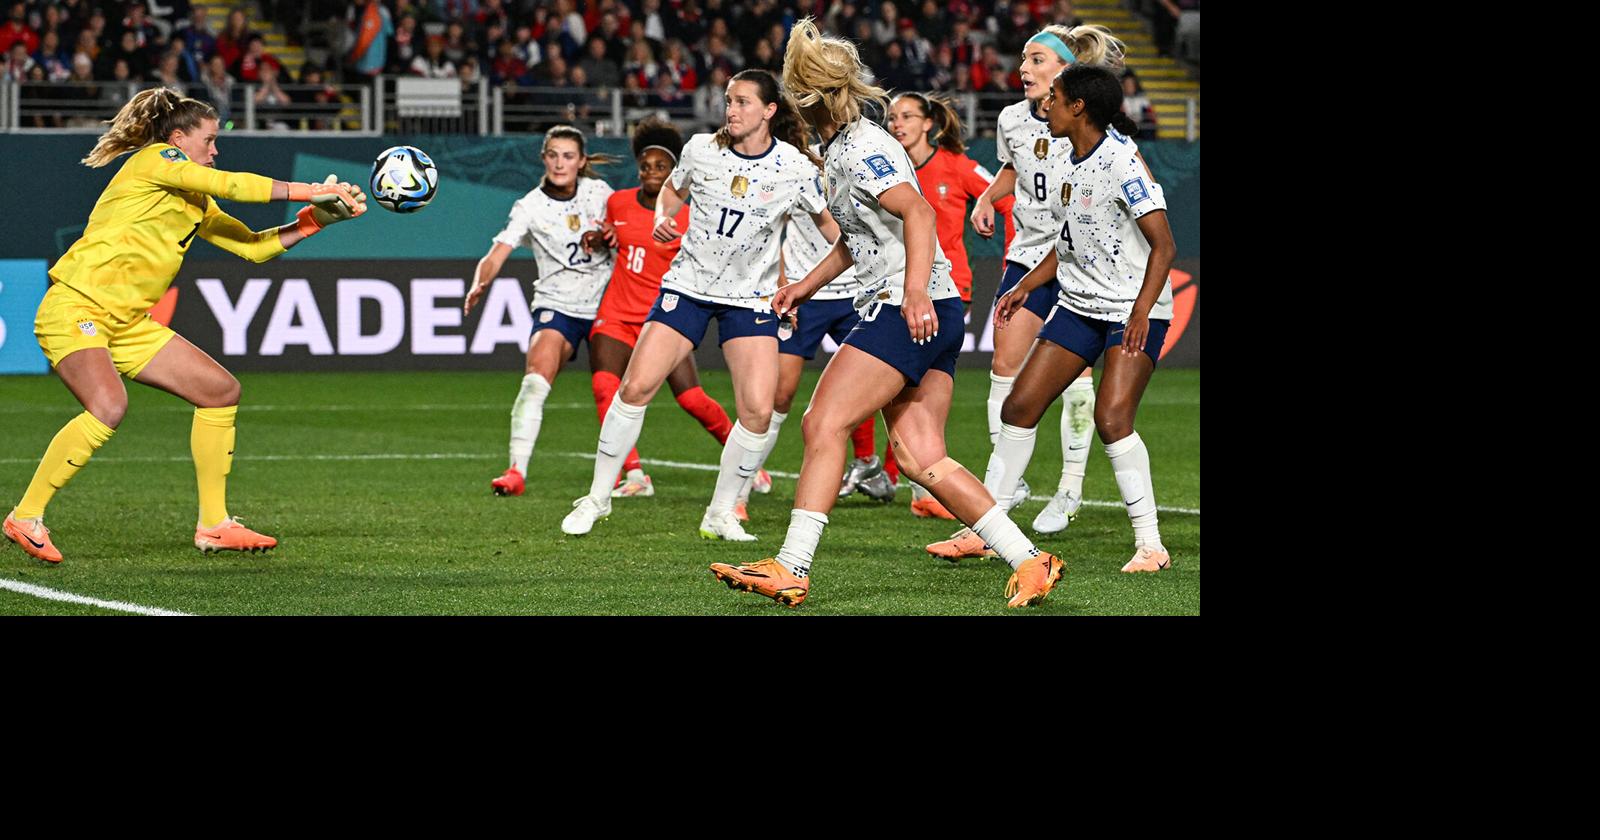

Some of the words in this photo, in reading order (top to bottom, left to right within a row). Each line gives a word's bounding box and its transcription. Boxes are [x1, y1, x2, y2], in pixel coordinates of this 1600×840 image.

[1034, 172, 1047, 202] 8
[1081, 188, 1093, 197] USA
[178, 222, 201, 248] 1
[716, 207, 745, 239] 17
[1060, 220, 1075, 251] 4
[626, 245, 646, 274] 16
[195, 278, 534, 355] YADEA
